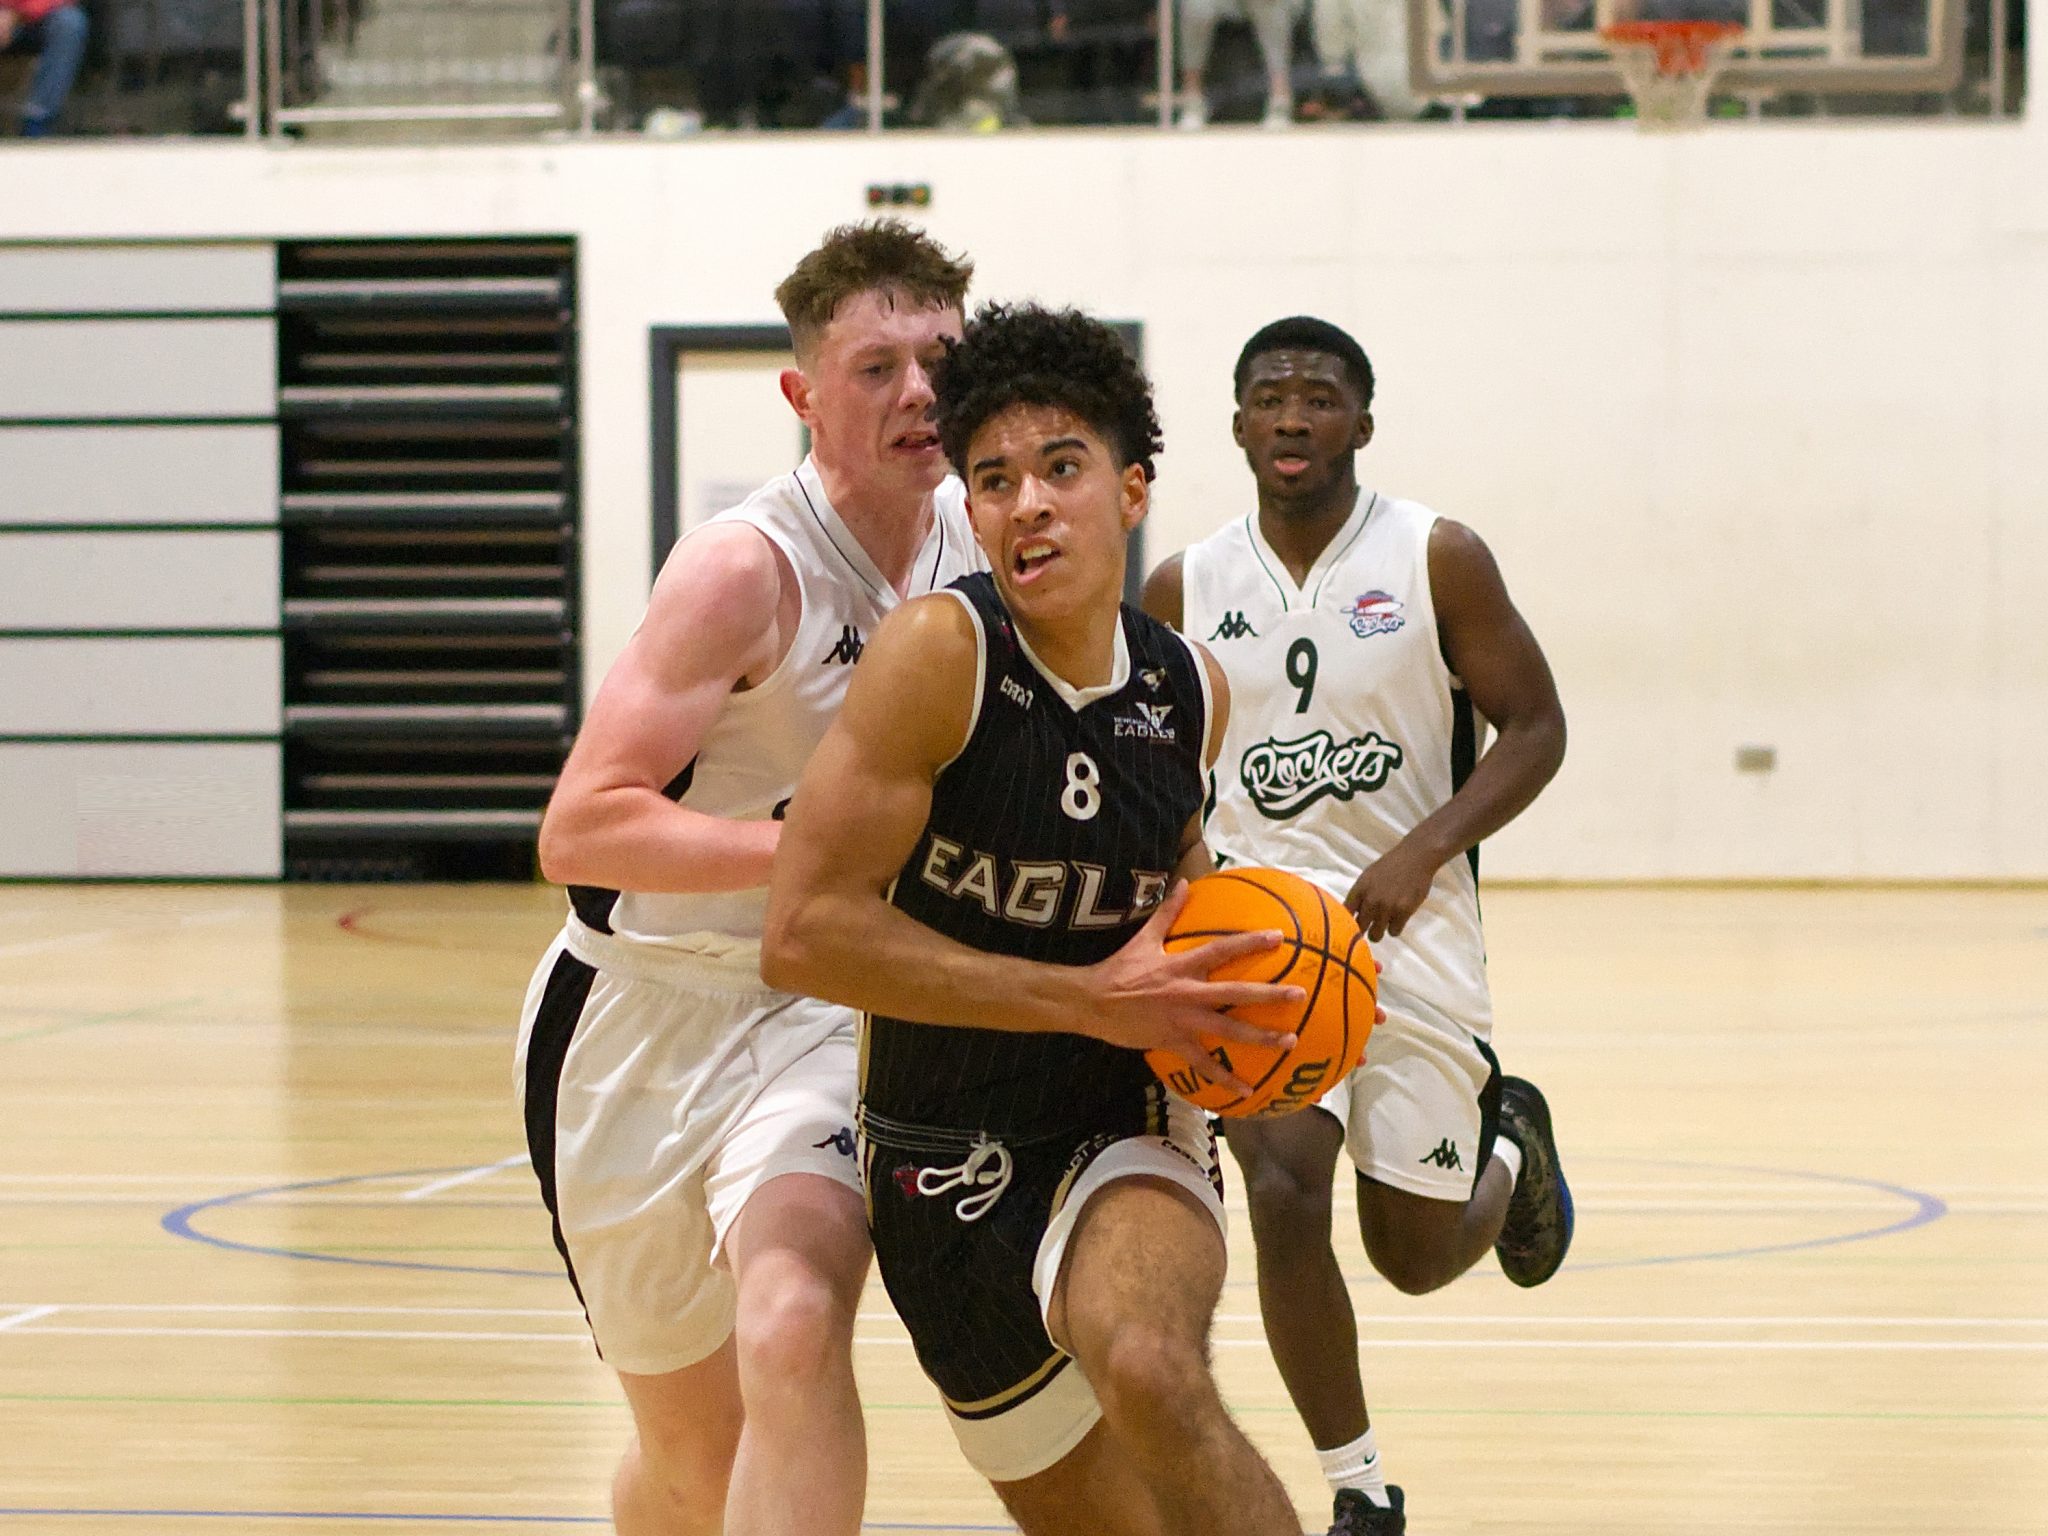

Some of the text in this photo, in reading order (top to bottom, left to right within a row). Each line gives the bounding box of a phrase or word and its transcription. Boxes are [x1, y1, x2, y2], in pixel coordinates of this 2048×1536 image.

[1285, 637, 1318, 714] 9
[1061, 752, 1101, 820] 8
[1240, 729, 1403, 820] Rockets
